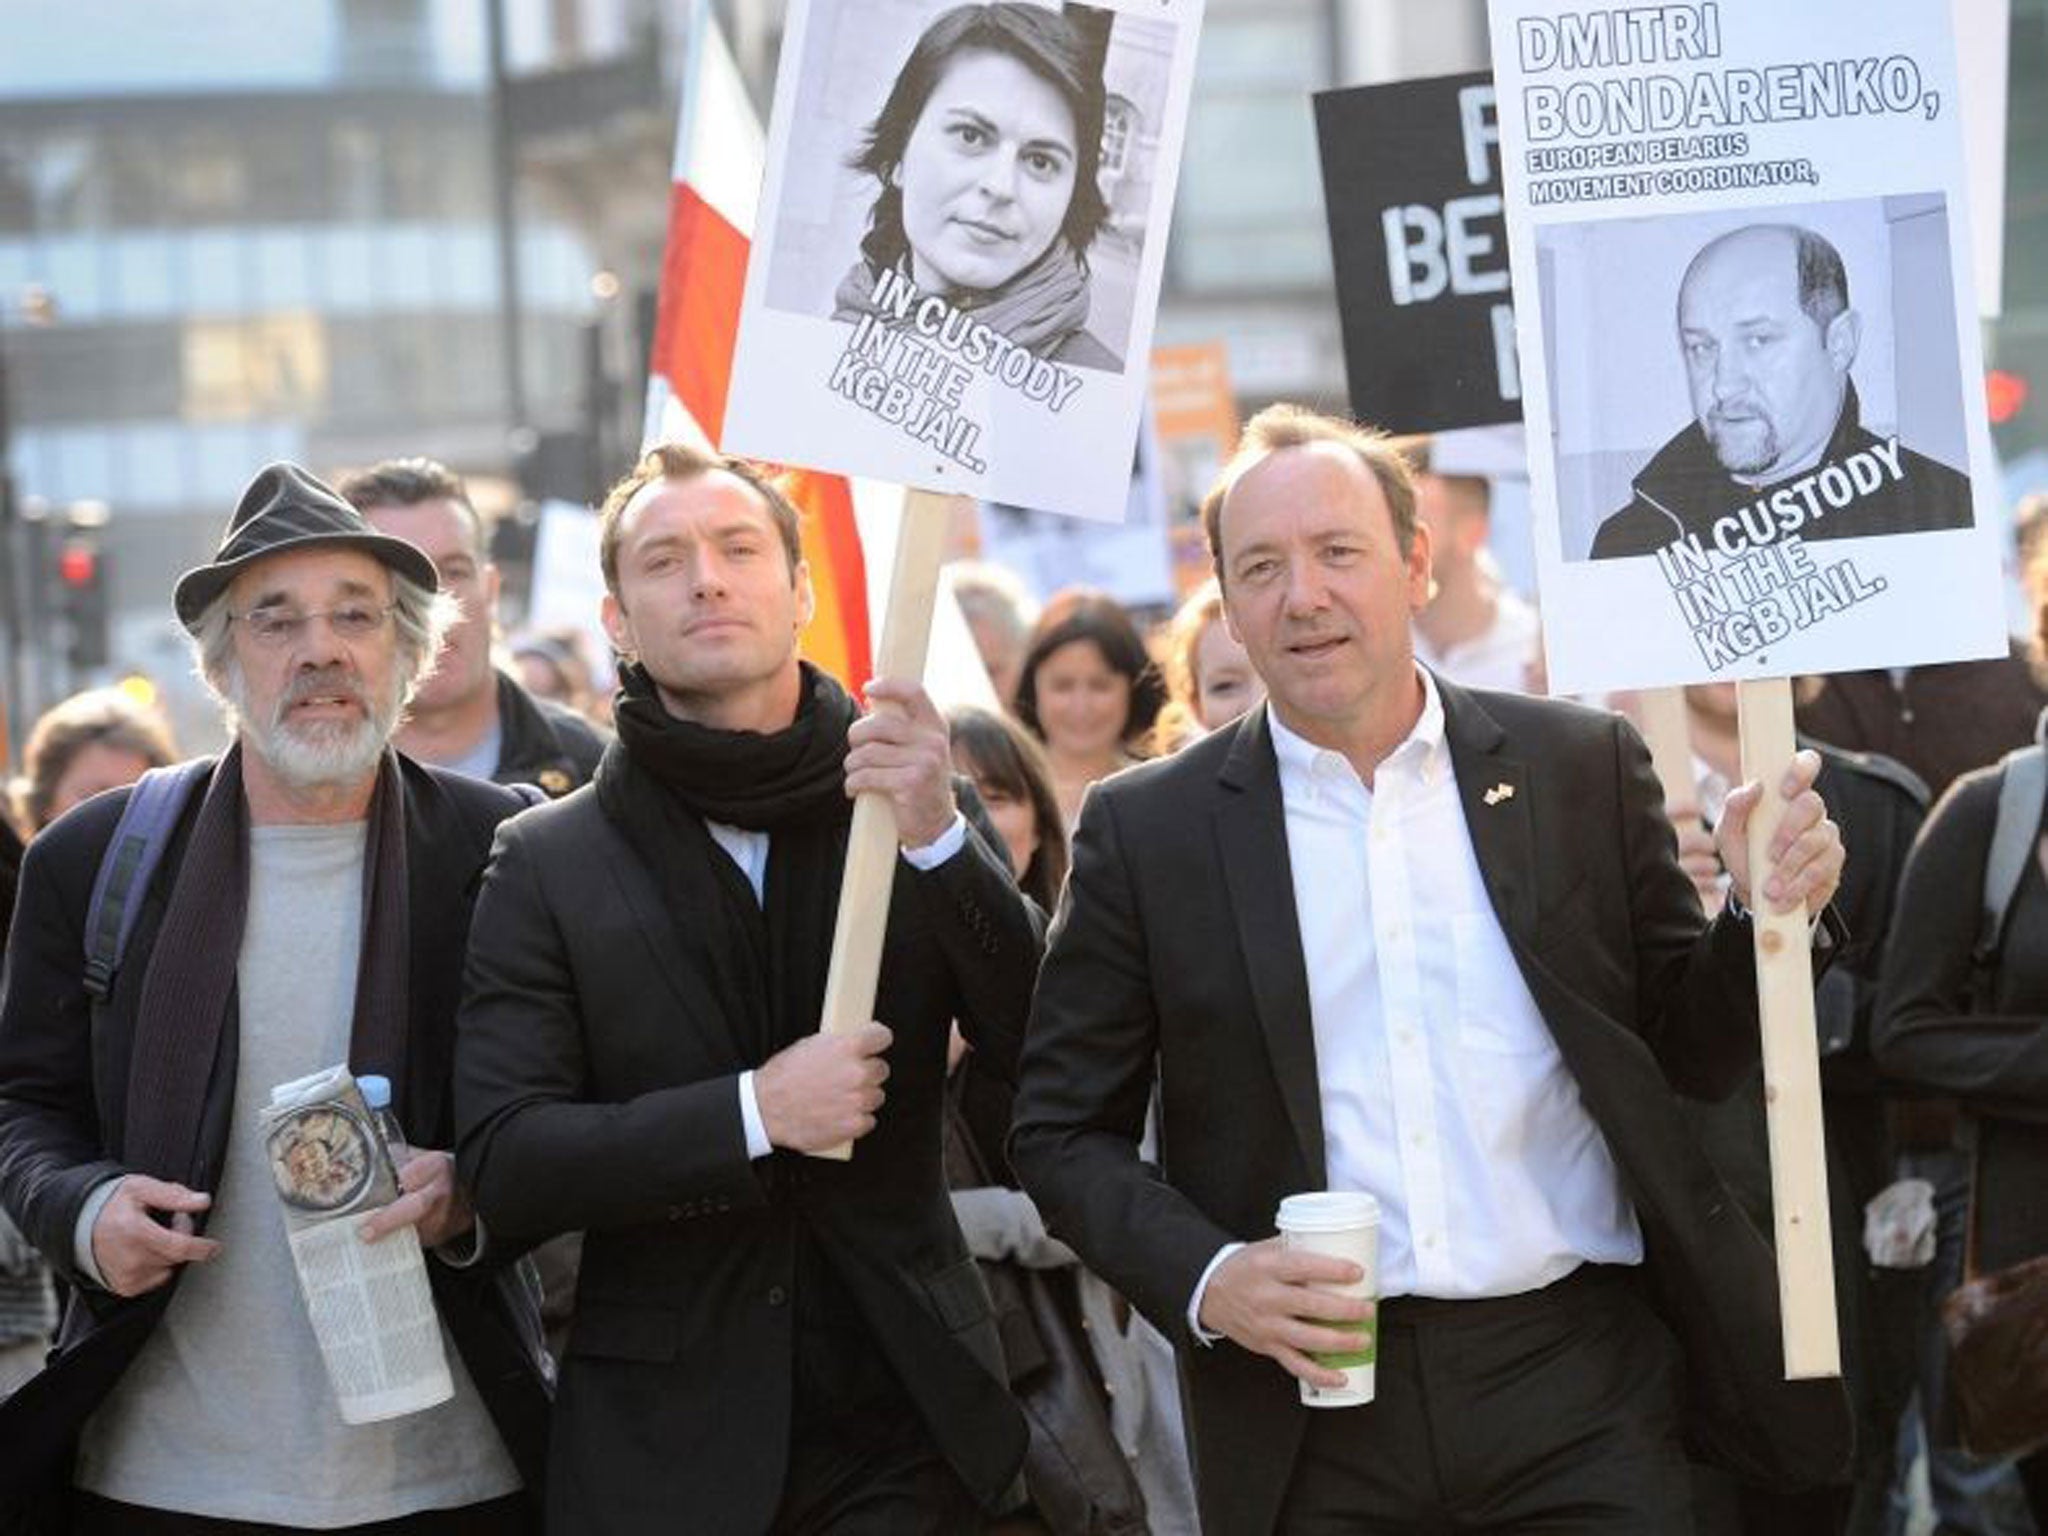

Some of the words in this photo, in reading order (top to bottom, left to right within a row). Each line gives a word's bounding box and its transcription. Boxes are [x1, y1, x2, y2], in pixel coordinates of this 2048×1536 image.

[1518, 4, 1721, 73] DMITRI
[1524, 55, 1940, 141] BONDARENKO,
[1526, 140, 1645, 173] EUROPEAN
[1648, 134, 1748, 164] BELARUS
[1529, 171, 1653, 205] MOVEMENT
[1656, 160, 1820, 196] COORDINATOR,
[849, 313, 898, 367] IN
[895, 333, 973, 409] THE
[871, 268, 917, 320] IN
[914, 294, 1083, 413] CUSTODY
[829, 351, 914, 425] KGB
[904, 398, 987, 475] JAIL.
[1656, 531, 1711, 587] IN
[1713, 435, 1907, 559] CUSTODY
[1675, 581, 1730, 630] IN
[1724, 534, 1817, 607] THE
[1694, 603, 1793, 672] KGB
[1789, 558, 1888, 628] JAIL.
